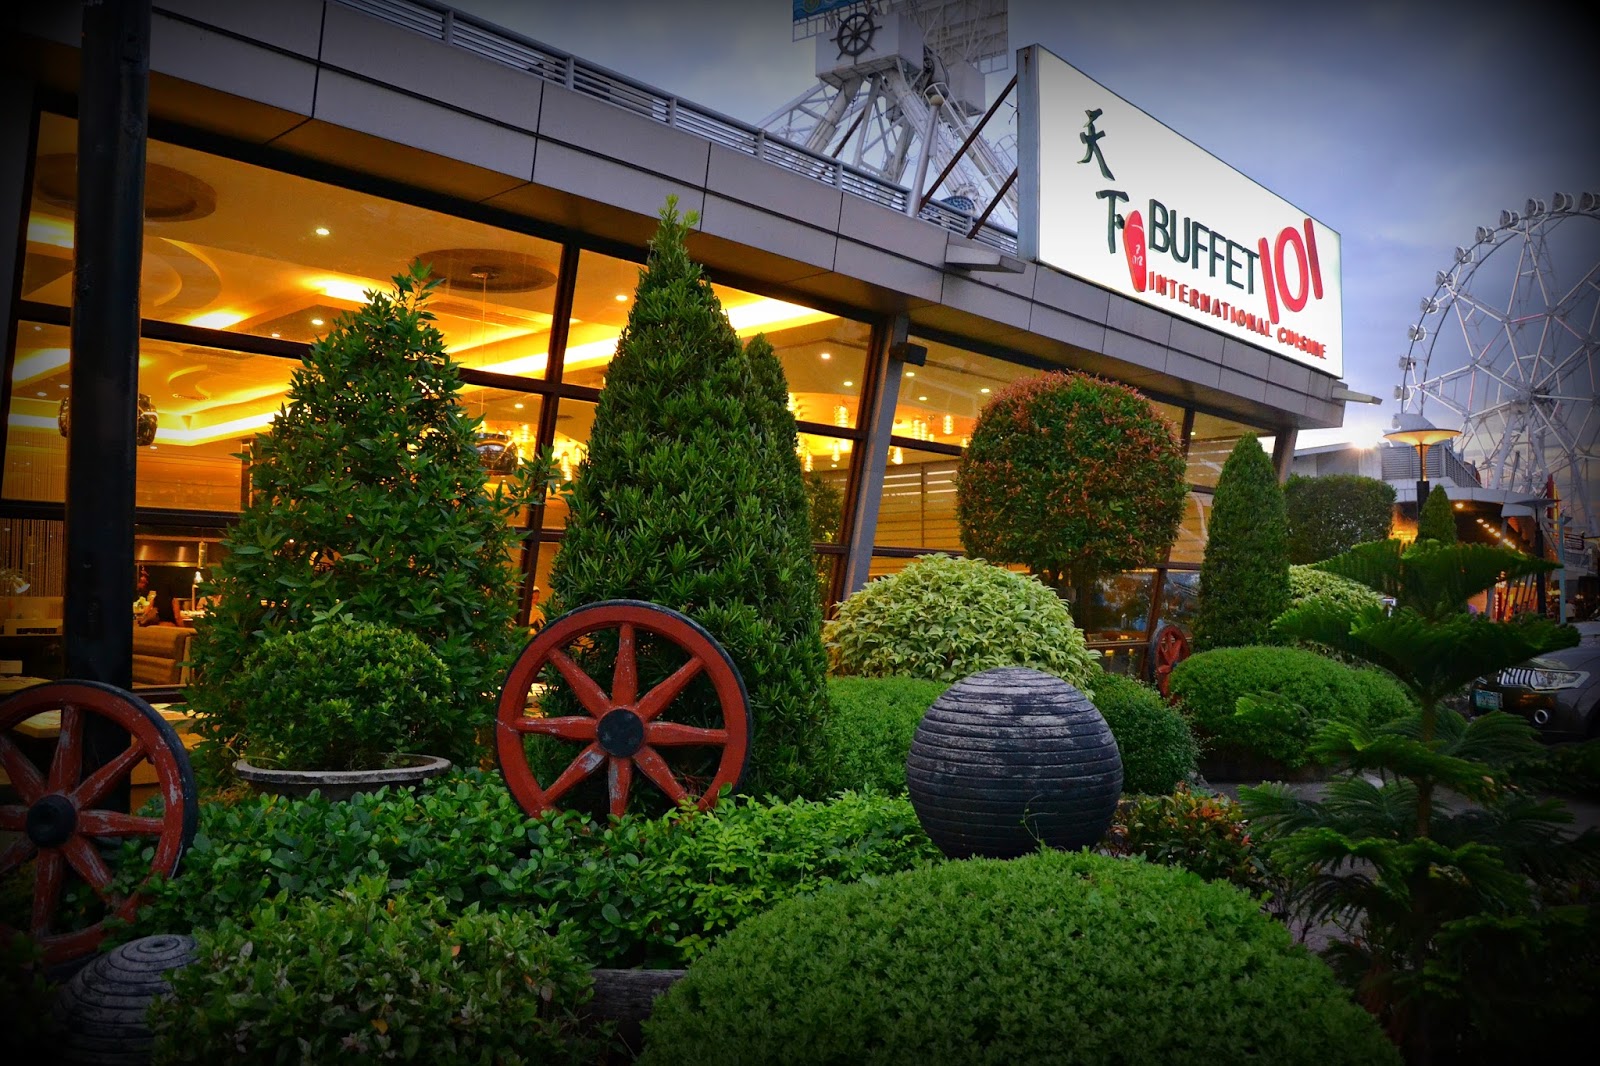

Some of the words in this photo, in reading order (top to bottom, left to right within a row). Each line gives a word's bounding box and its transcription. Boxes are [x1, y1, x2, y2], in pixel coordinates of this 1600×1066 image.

[1149, 199, 1259, 294] BUFFET
[1258, 218, 1323, 324] 101
[1149, 271, 1272, 337] INTERNATIONAL
[1277, 327, 1327, 359] CUISINE
